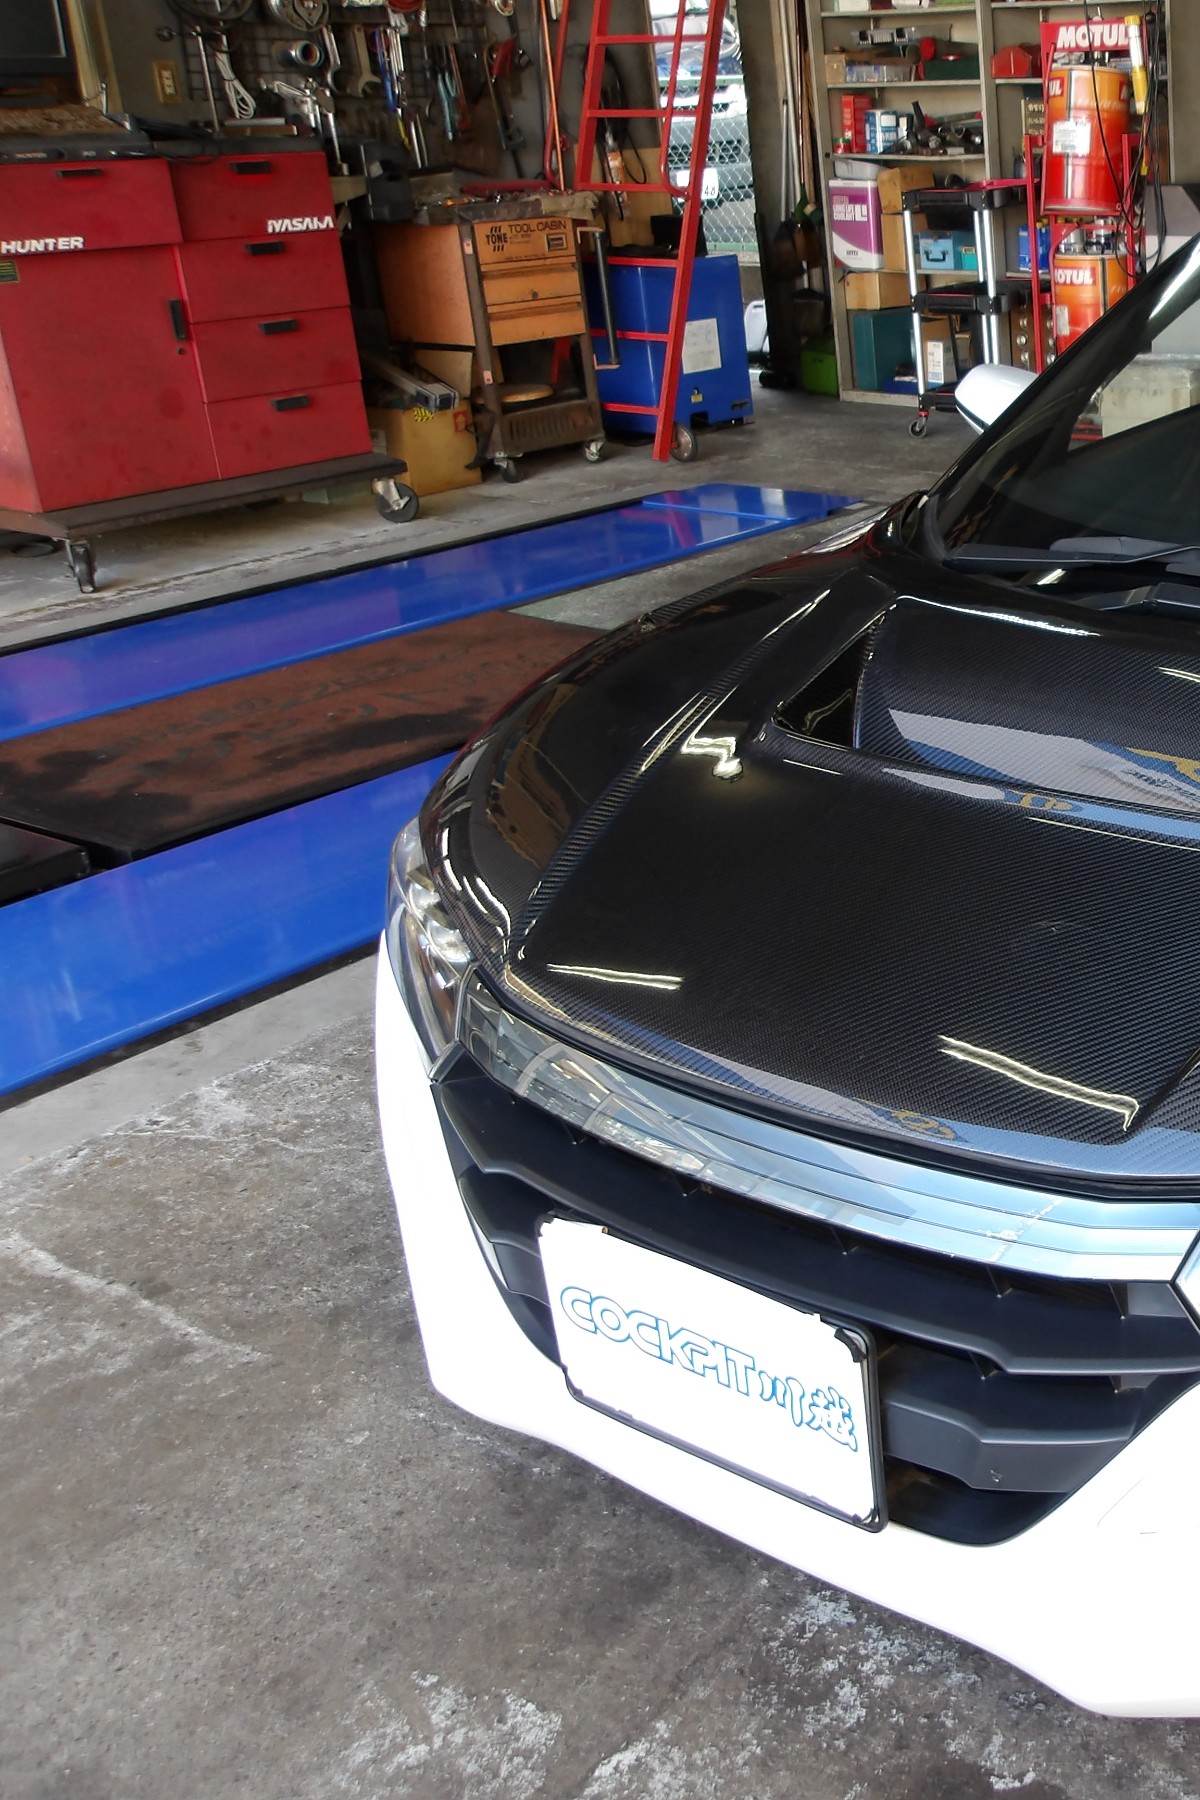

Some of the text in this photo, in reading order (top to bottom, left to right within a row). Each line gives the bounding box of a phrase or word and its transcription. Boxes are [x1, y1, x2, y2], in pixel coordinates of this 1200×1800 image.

[1057, 23, 1129, 48] MOTUL
[508, 223, 536, 234] TOOL
[1, 237, 84, 253] HUNTER
[485, 233, 509, 245] TONE
[1055, 268, 1094, 285] OTUL
[560, 1286, 858, 1452] COCKPIT 川越
